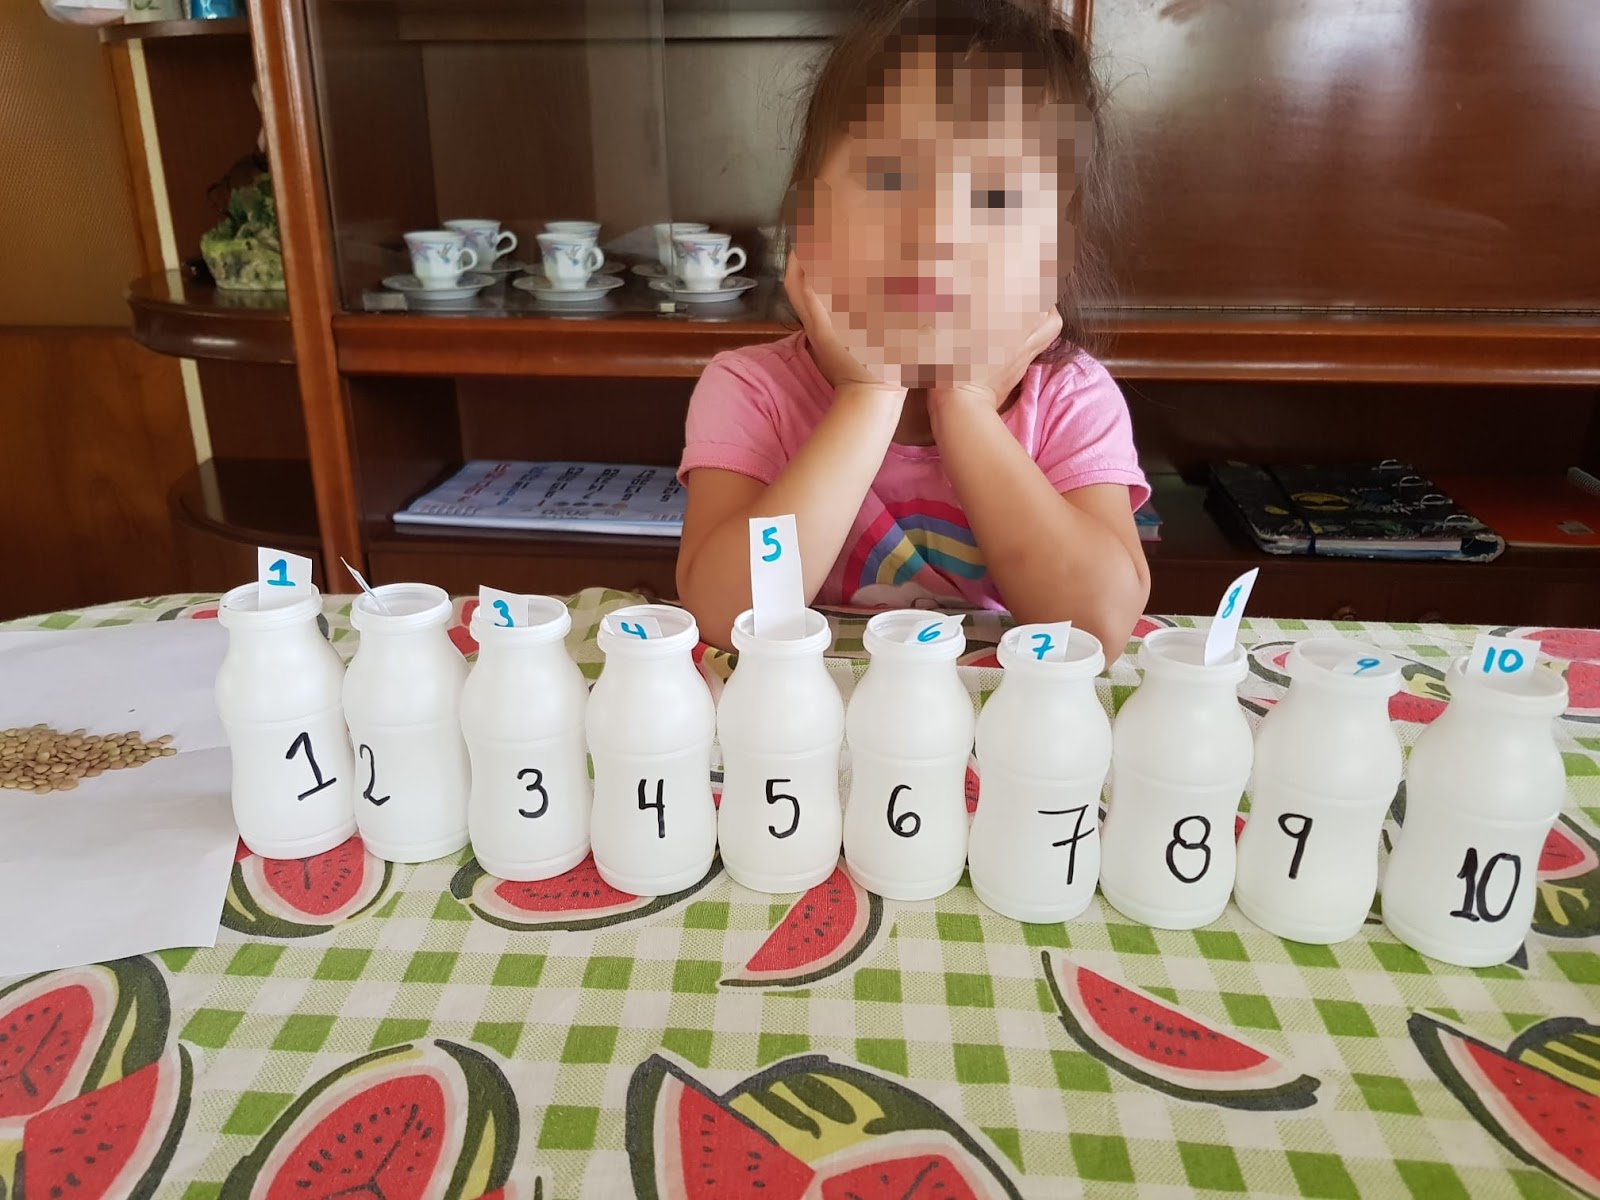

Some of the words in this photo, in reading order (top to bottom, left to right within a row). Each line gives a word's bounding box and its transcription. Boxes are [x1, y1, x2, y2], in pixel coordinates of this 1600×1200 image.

[762, 526, 782, 562] 5
[267, 559, 295, 587] 1
[493, 600, 514, 628] 3
[1222, 586, 1242, 619] 8
[621, 621, 647, 640] 4
[917, 622, 943, 643] 6
[1031, 633, 1054, 661] 7
[1354, 658, 1380, 675] 9
[1483, 646, 1525, 674] 10
[286, 732, 336, 800] 1
[360, 744, 390, 806] 2
[517, 768, 549, 818] 3
[638, 779, 665, 838] 4
[766, 779, 800, 838] 5
[887, 785, 921, 837] 6
[1038, 805, 1095, 885] 7
[1166, 815, 1210, 883] 8
[1278, 813, 1313, 879] 9
[1450, 848, 1521, 922] 10
